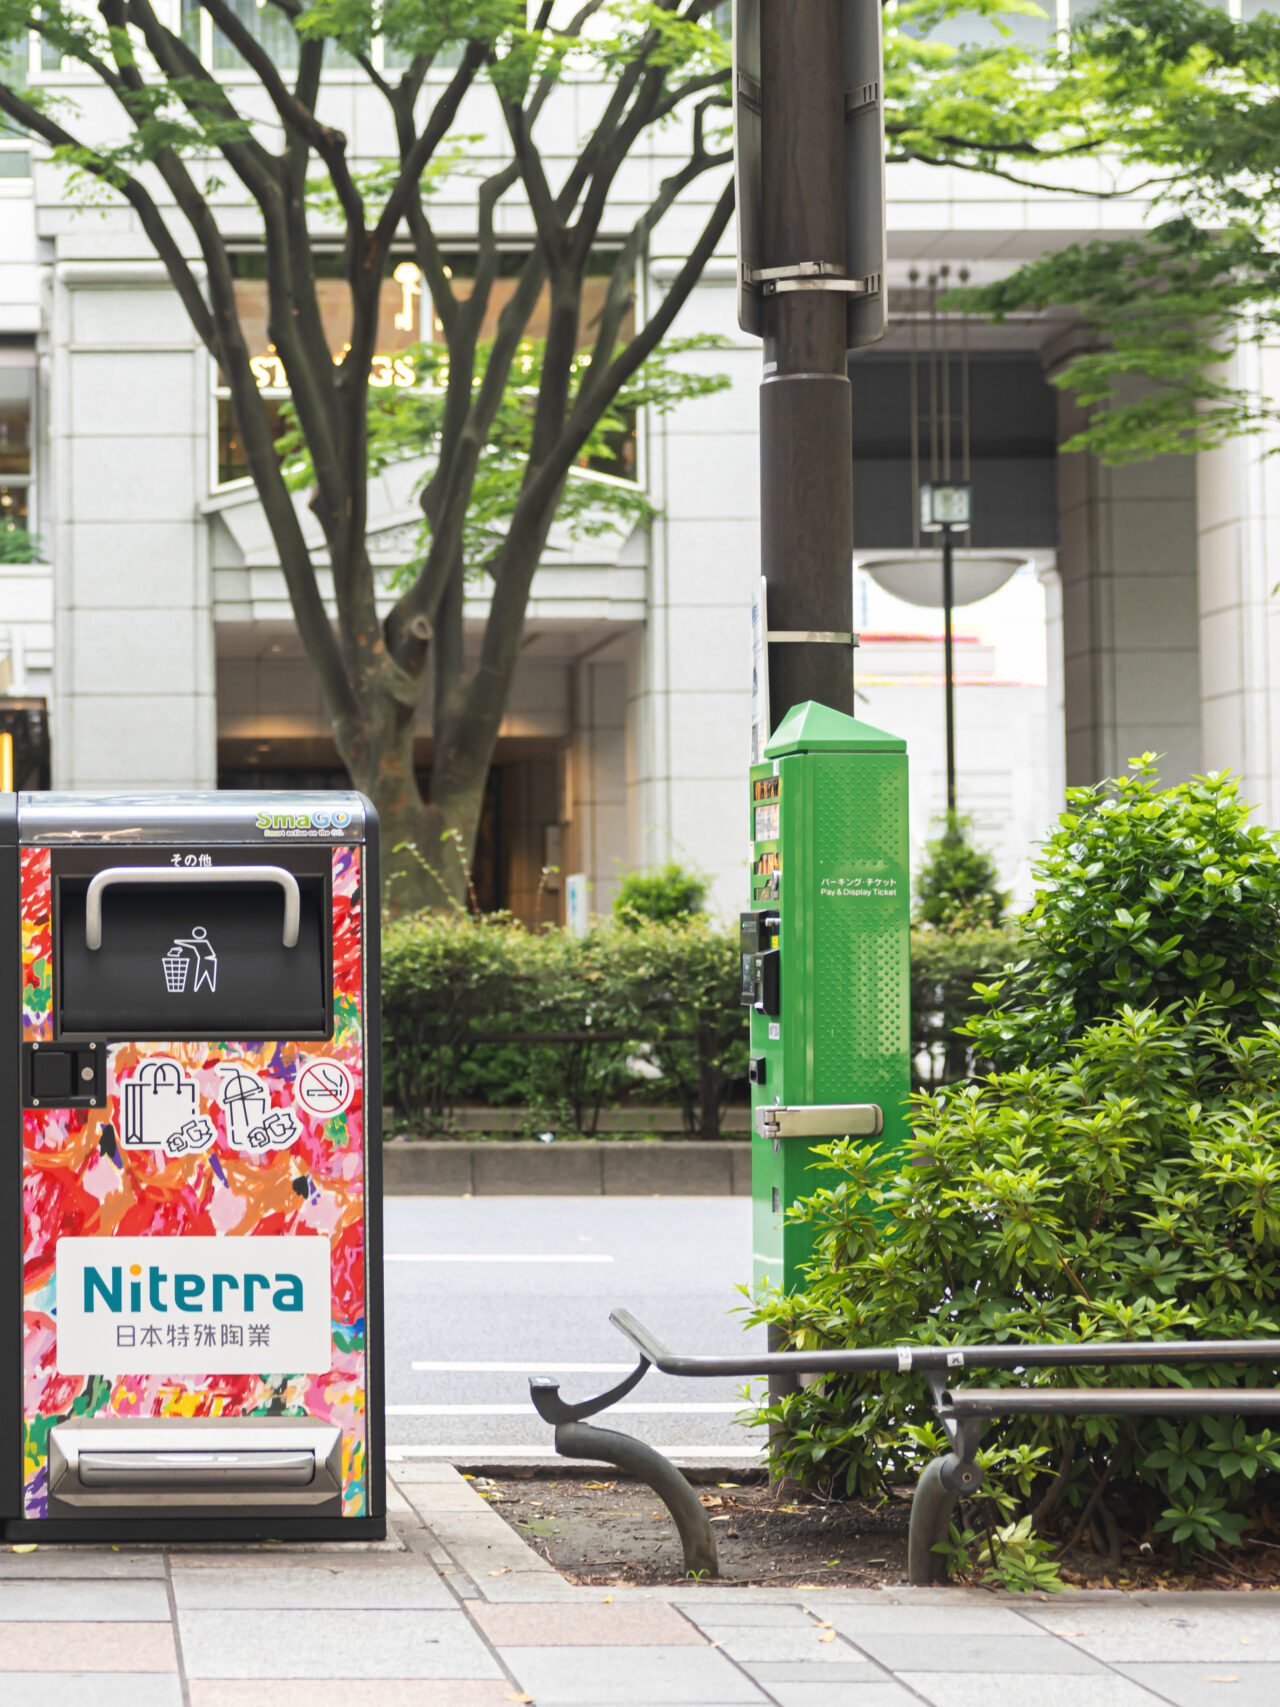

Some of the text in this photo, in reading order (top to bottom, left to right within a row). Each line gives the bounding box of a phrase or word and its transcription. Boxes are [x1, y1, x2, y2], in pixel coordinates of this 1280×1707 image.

[249, 355, 417, 388] STGS
[256, 810, 352, 829] SmaGO
[170, 853, 212, 867] その他
[821, 888, 896, 896] Pay & Display Ticket
[84, 1264, 304, 1313] Niterra
[117, 1324, 271, 1347] 日本特殊陶業
